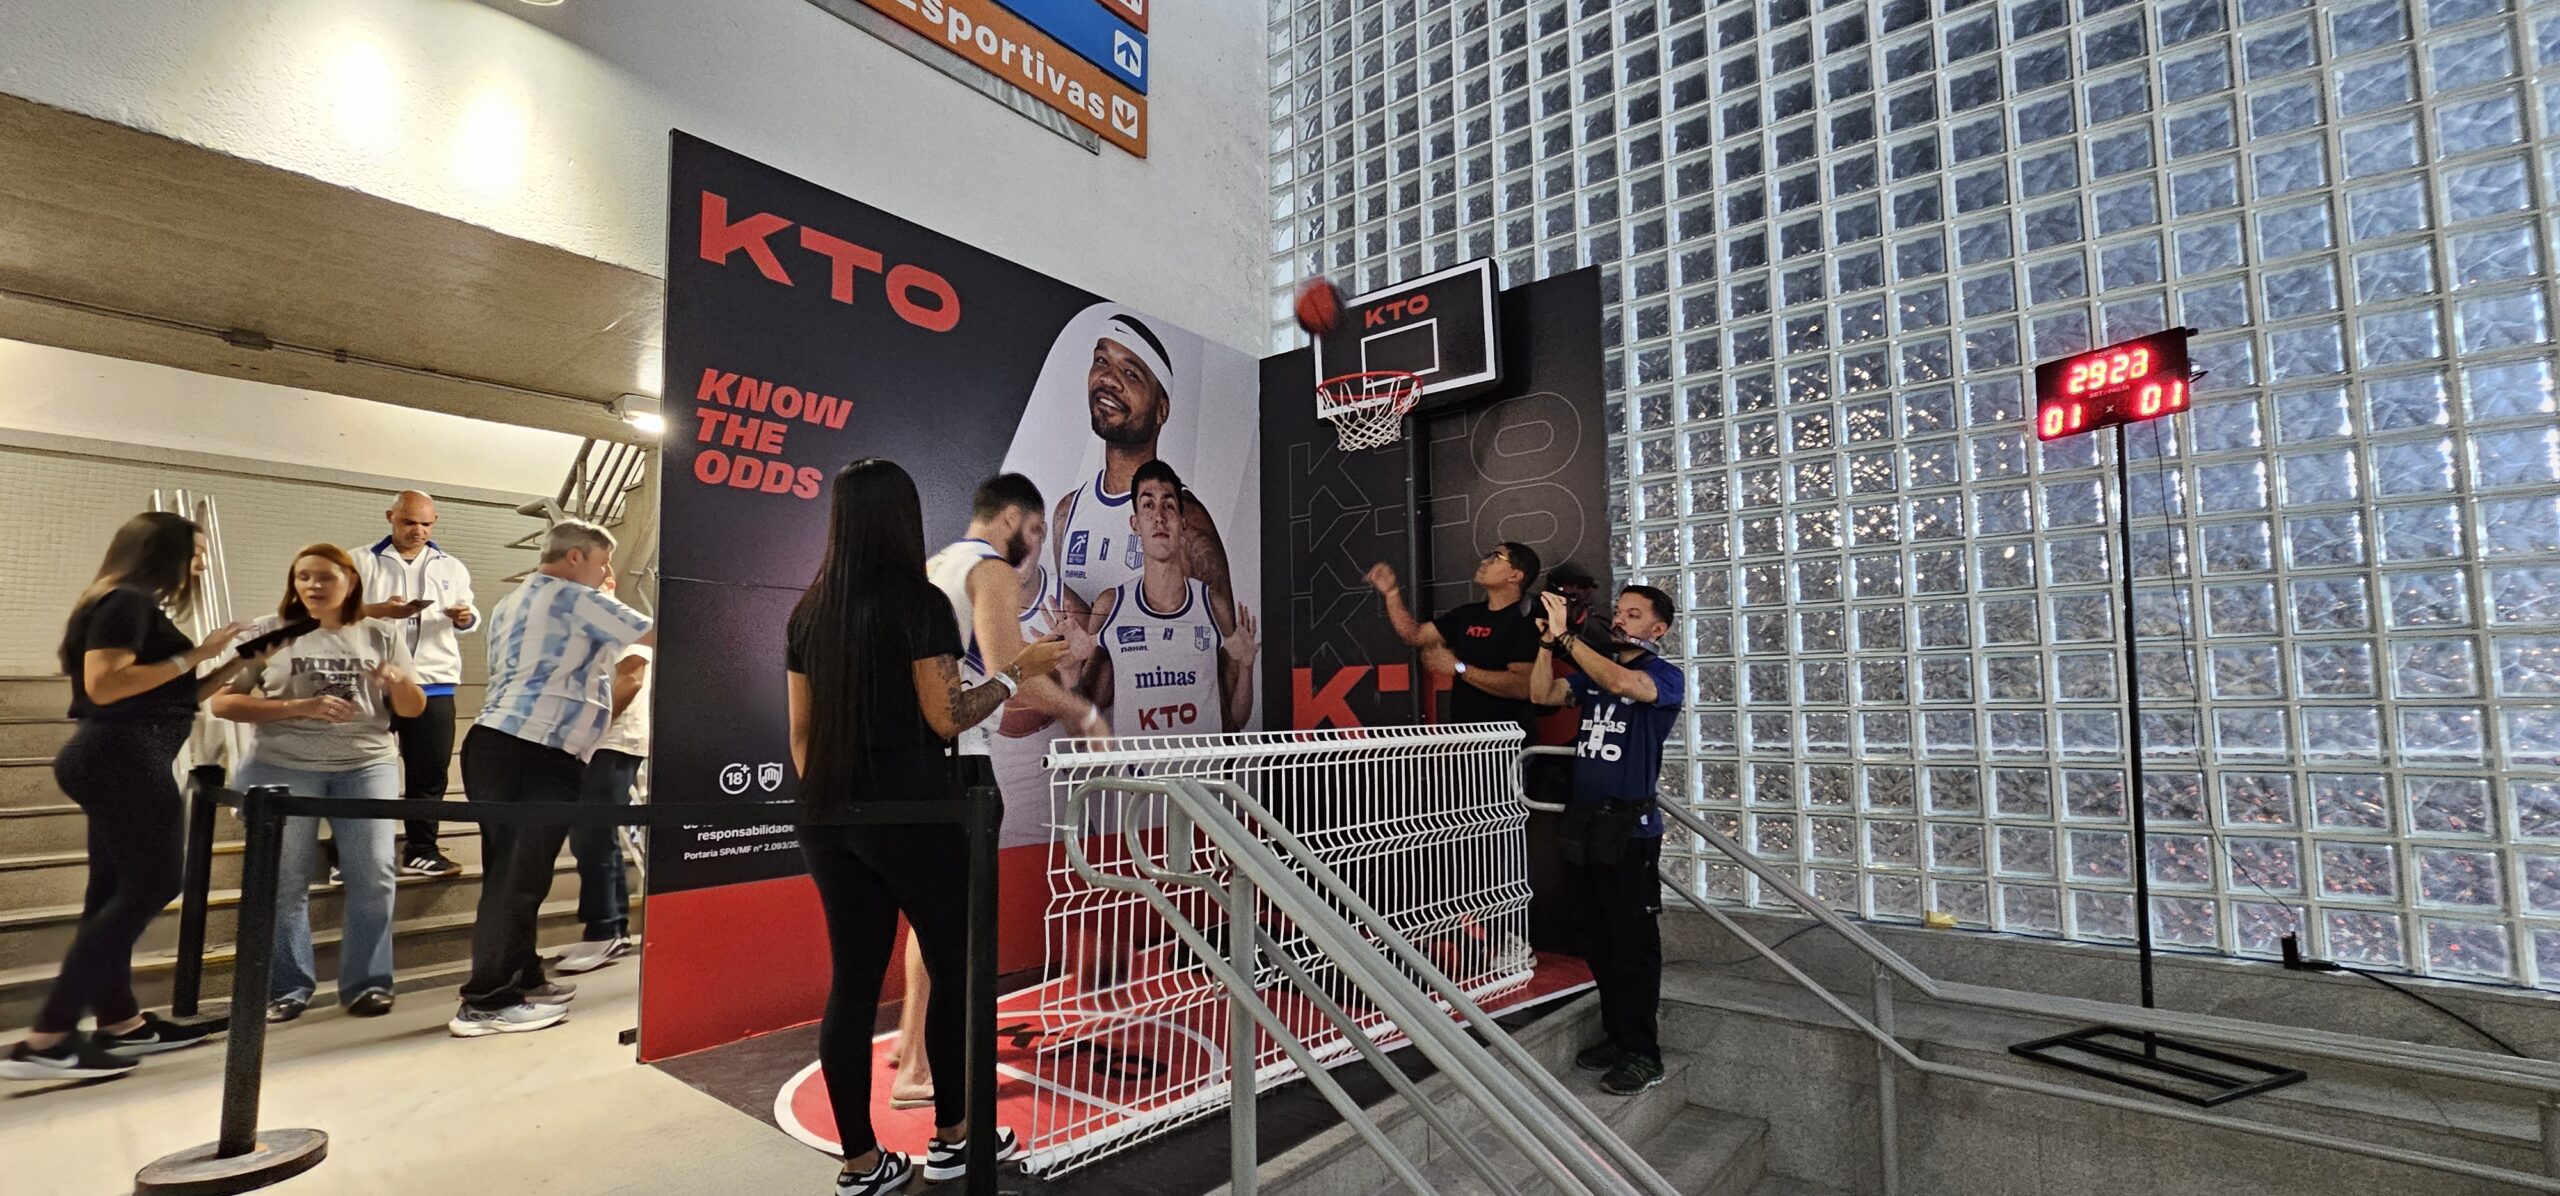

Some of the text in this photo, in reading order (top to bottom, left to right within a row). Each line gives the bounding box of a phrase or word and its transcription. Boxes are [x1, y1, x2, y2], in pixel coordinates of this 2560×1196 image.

[896, 0, 1105, 120] sportivas
[699, 190, 961, 333] KTO
[1365, 294, 1429, 329] KTO
[697, 368, 854, 430] KNOW
[2043, 403, 2082, 437] 01
[2140, 380, 2183, 415] 01
[696, 407, 788, 455] THE
[694, 449, 823, 500] ODDS
[1465, 625, 1491, 638] KTO
[291, 657, 376, 676] MINAS
[1134, 665, 1197, 689] minas
[1138, 702, 1197, 731] KTO
[684, 850, 718, 860] Portaria
[719, 845, 752, 857] SPA/MF
